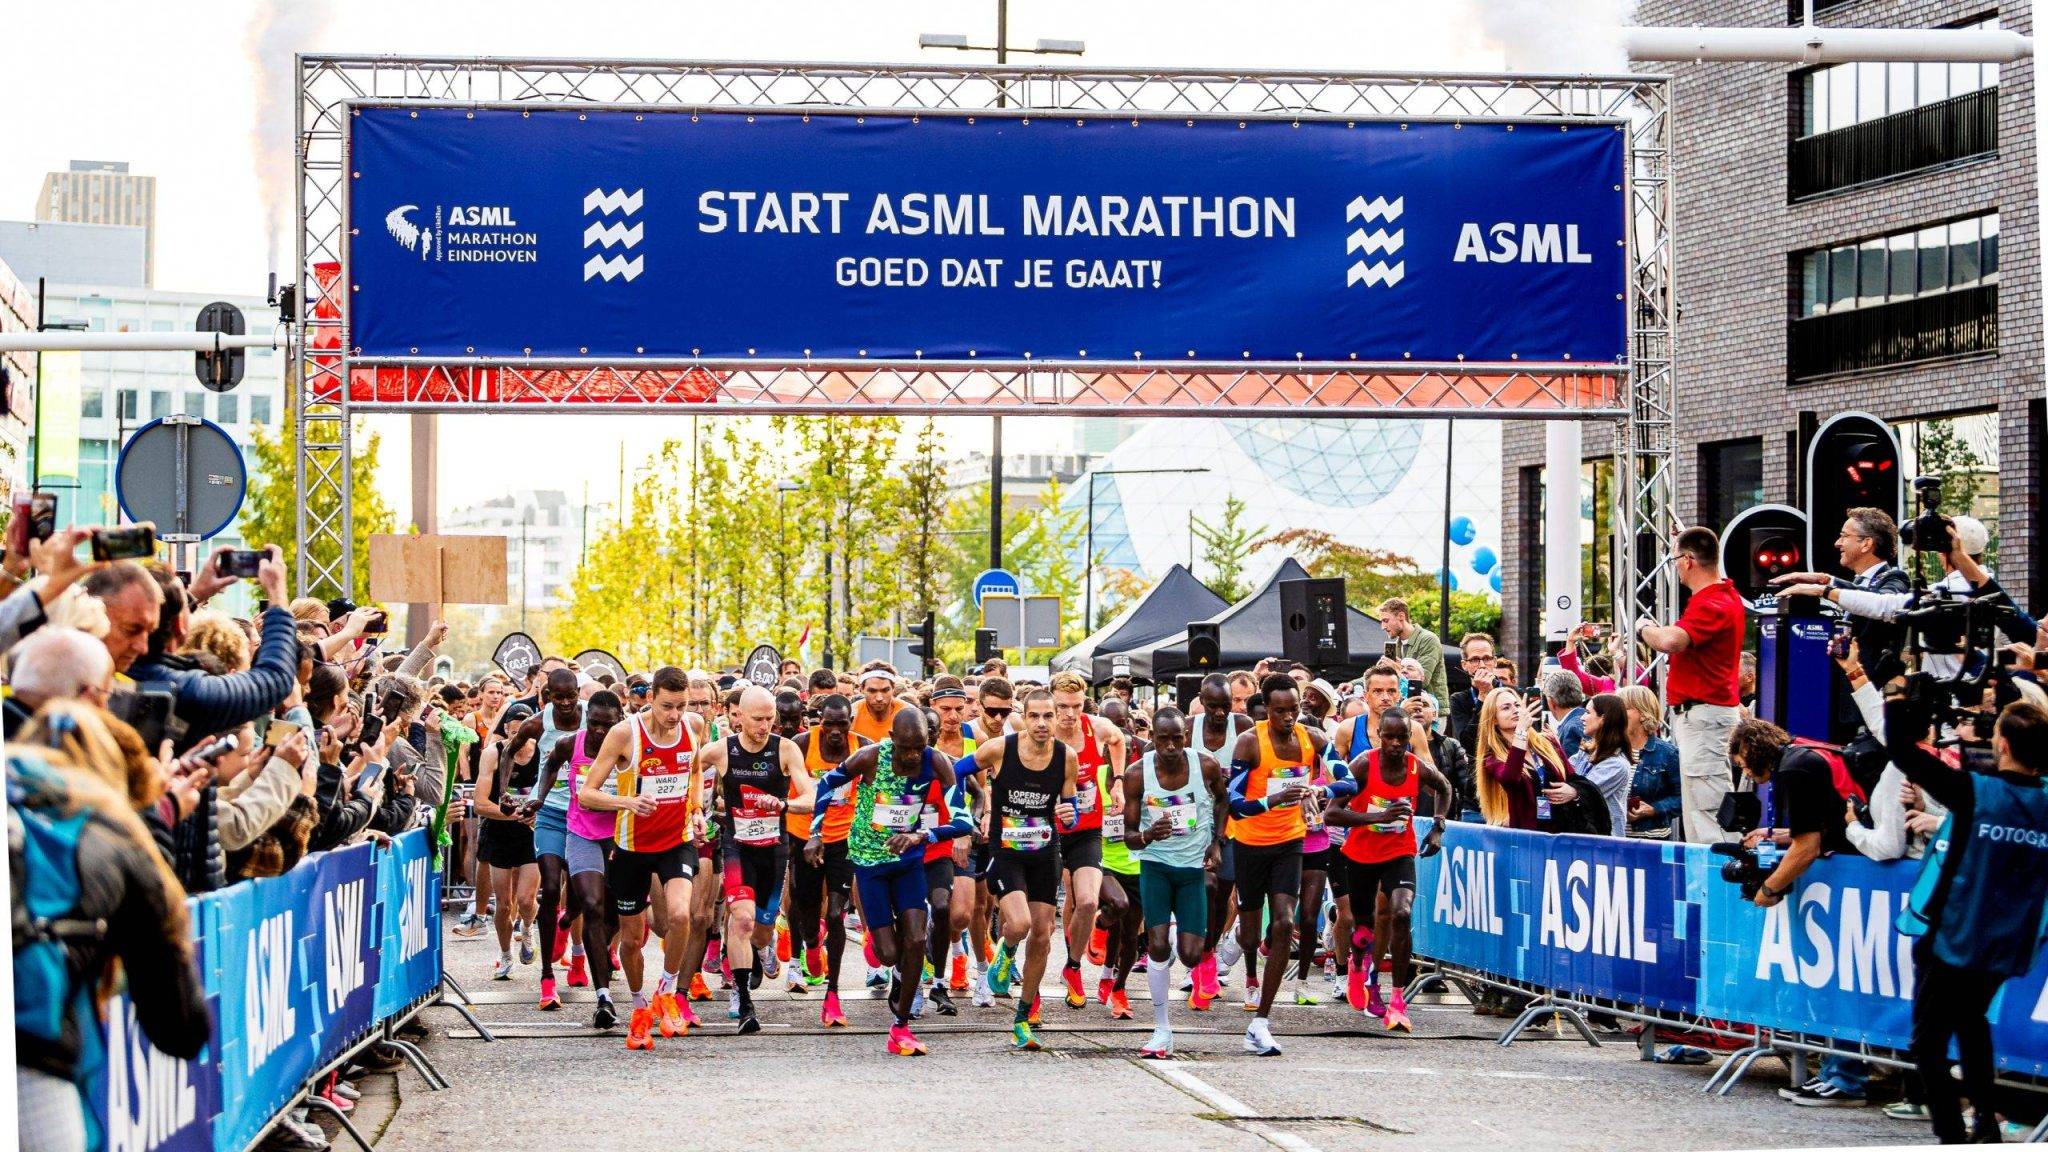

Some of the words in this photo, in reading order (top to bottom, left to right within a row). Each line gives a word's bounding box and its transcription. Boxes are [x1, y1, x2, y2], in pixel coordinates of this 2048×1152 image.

[448, 206, 516, 226] ASML
[698, 190, 849, 234] START
[865, 193, 1005, 236] ASML
[1023, 194, 1296, 238] MARATHON
[448, 232, 537, 245] MARATHON
[448, 249, 537, 262] EINDHOVEN
[1453, 222, 1592, 264] ASML
[836, 257, 929, 287] GOED
[941, 258, 1003, 288] DAT
[1014, 259, 1053, 288] JE
[1065, 259, 1162, 289] GAAT!
[655, 776, 678, 784] WARD
[657, 785, 675, 794] 227
[1434, 846, 1503, 935] ASML
[1540, 859, 1657, 963] ASML
[325, 878, 364, 1014] ASML
[246, 910, 296, 1076] ASML
